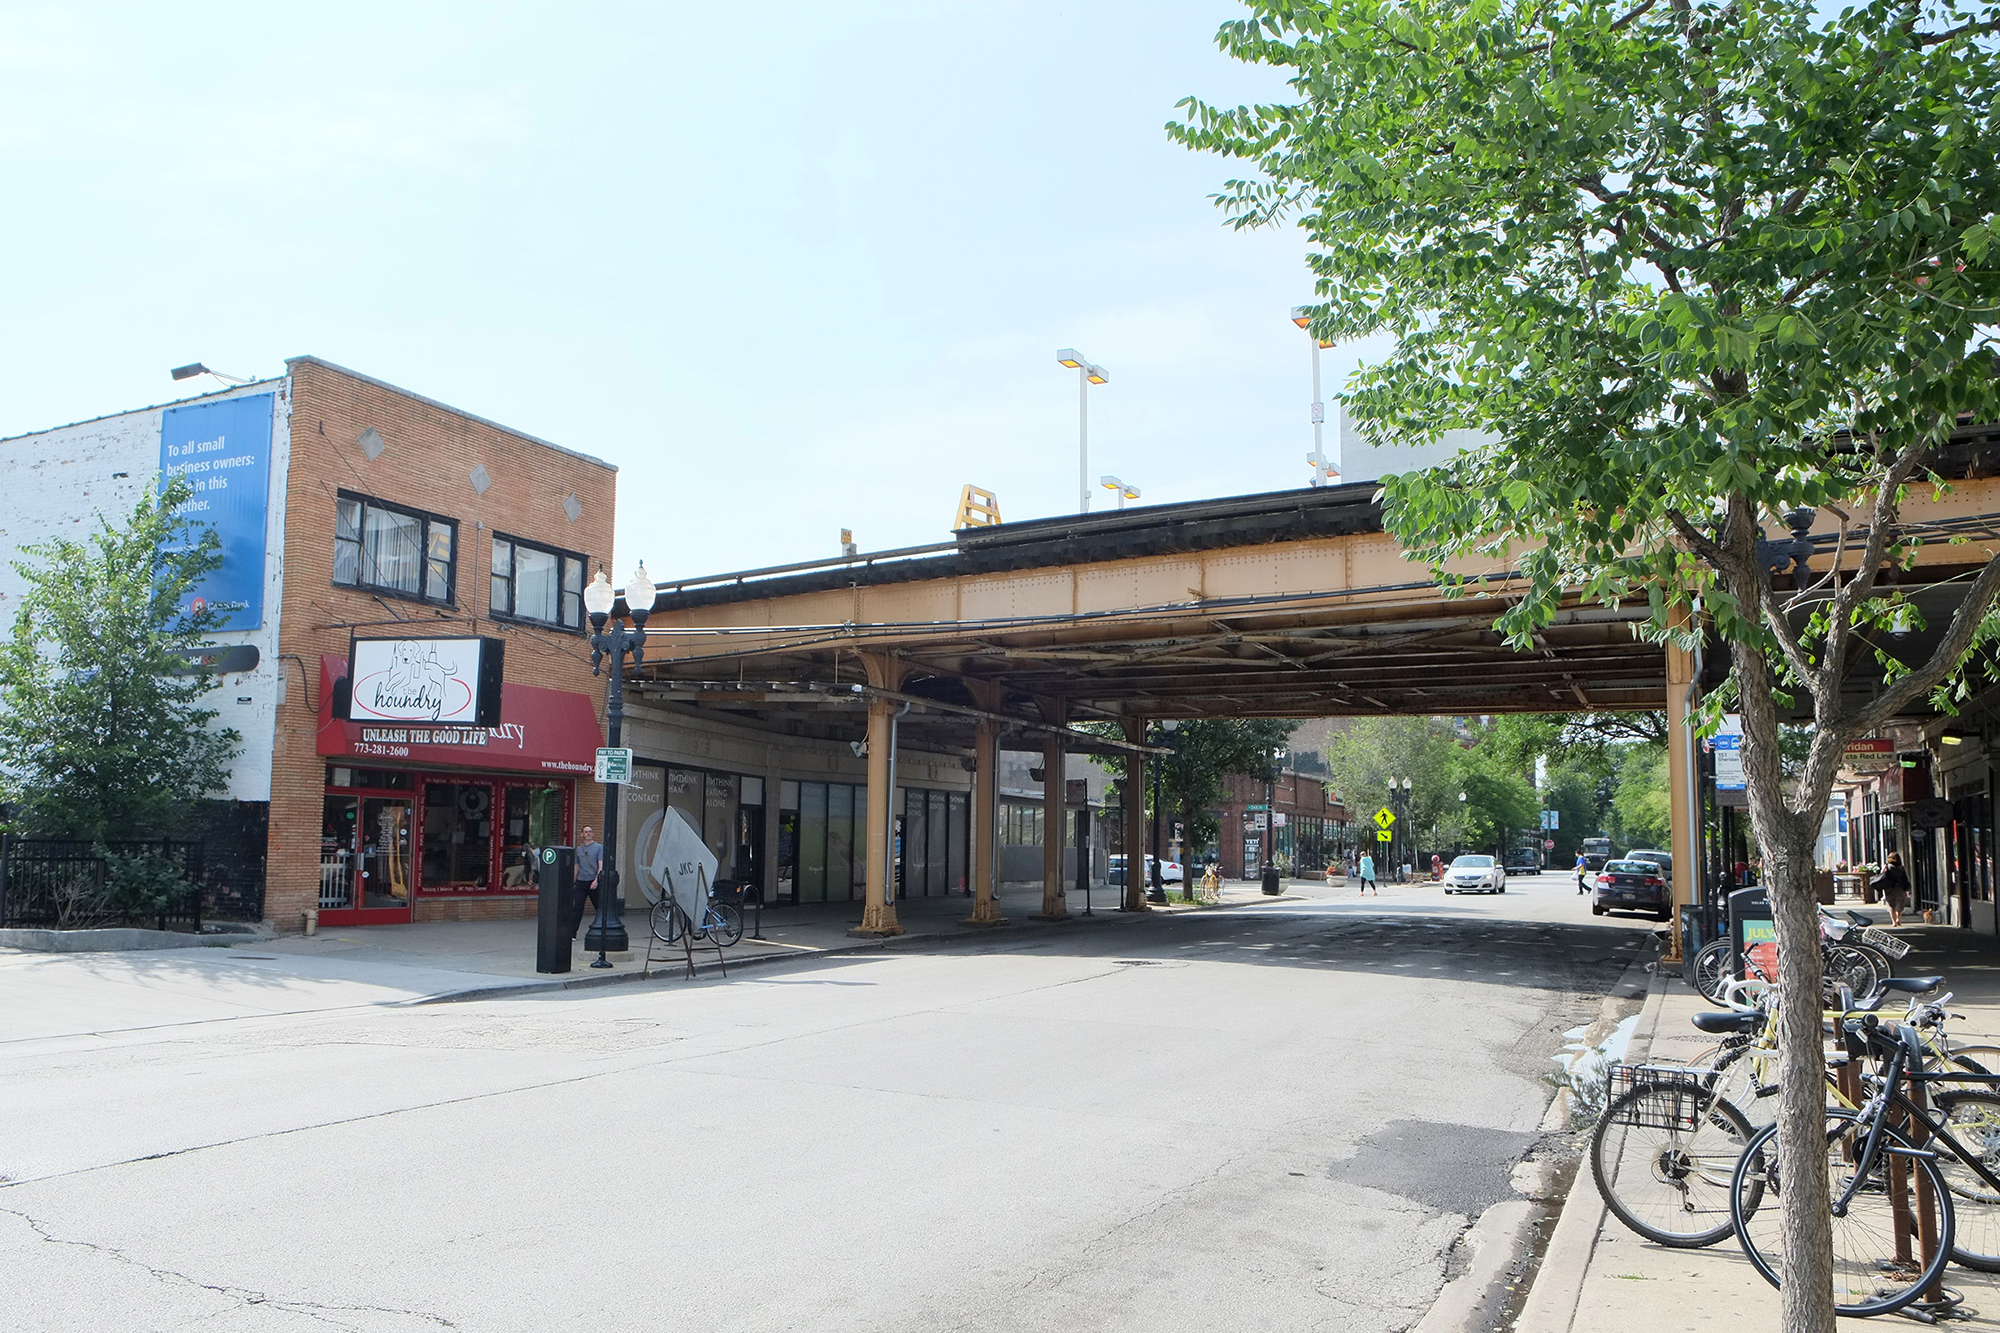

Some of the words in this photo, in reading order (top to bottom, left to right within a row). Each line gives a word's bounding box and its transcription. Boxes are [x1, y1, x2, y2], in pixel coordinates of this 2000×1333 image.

[168, 444, 179, 457] To
[182, 440, 194, 454] all
[197, 436, 225, 453] small
[166, 461, 210, 476] business
[213, 455, 254, 470] owners:
[196, 479, 205, 492] in
[208, 476, 228, 490] this
[402, 686, 417, 696] the
[374, 682, 442, 721] houndry
[362, 728, 408, 742] UNLEASH
[410, 730, 430, 744] THE
[432, 730, 460, 744] GOOD
[462, 731, 486, 745] LIFE
[354, 742, 409, 756] 773-281-2600
[668, 784, 684, 794] HAM
[706, 788, 728, 797] EATING
[626, 792, 660, 803] CONTACT
[706, 799, 726, 808] ALONE
[679, 862, 694, 876] JKC
[1747, 928, 1775, 940] JULY
